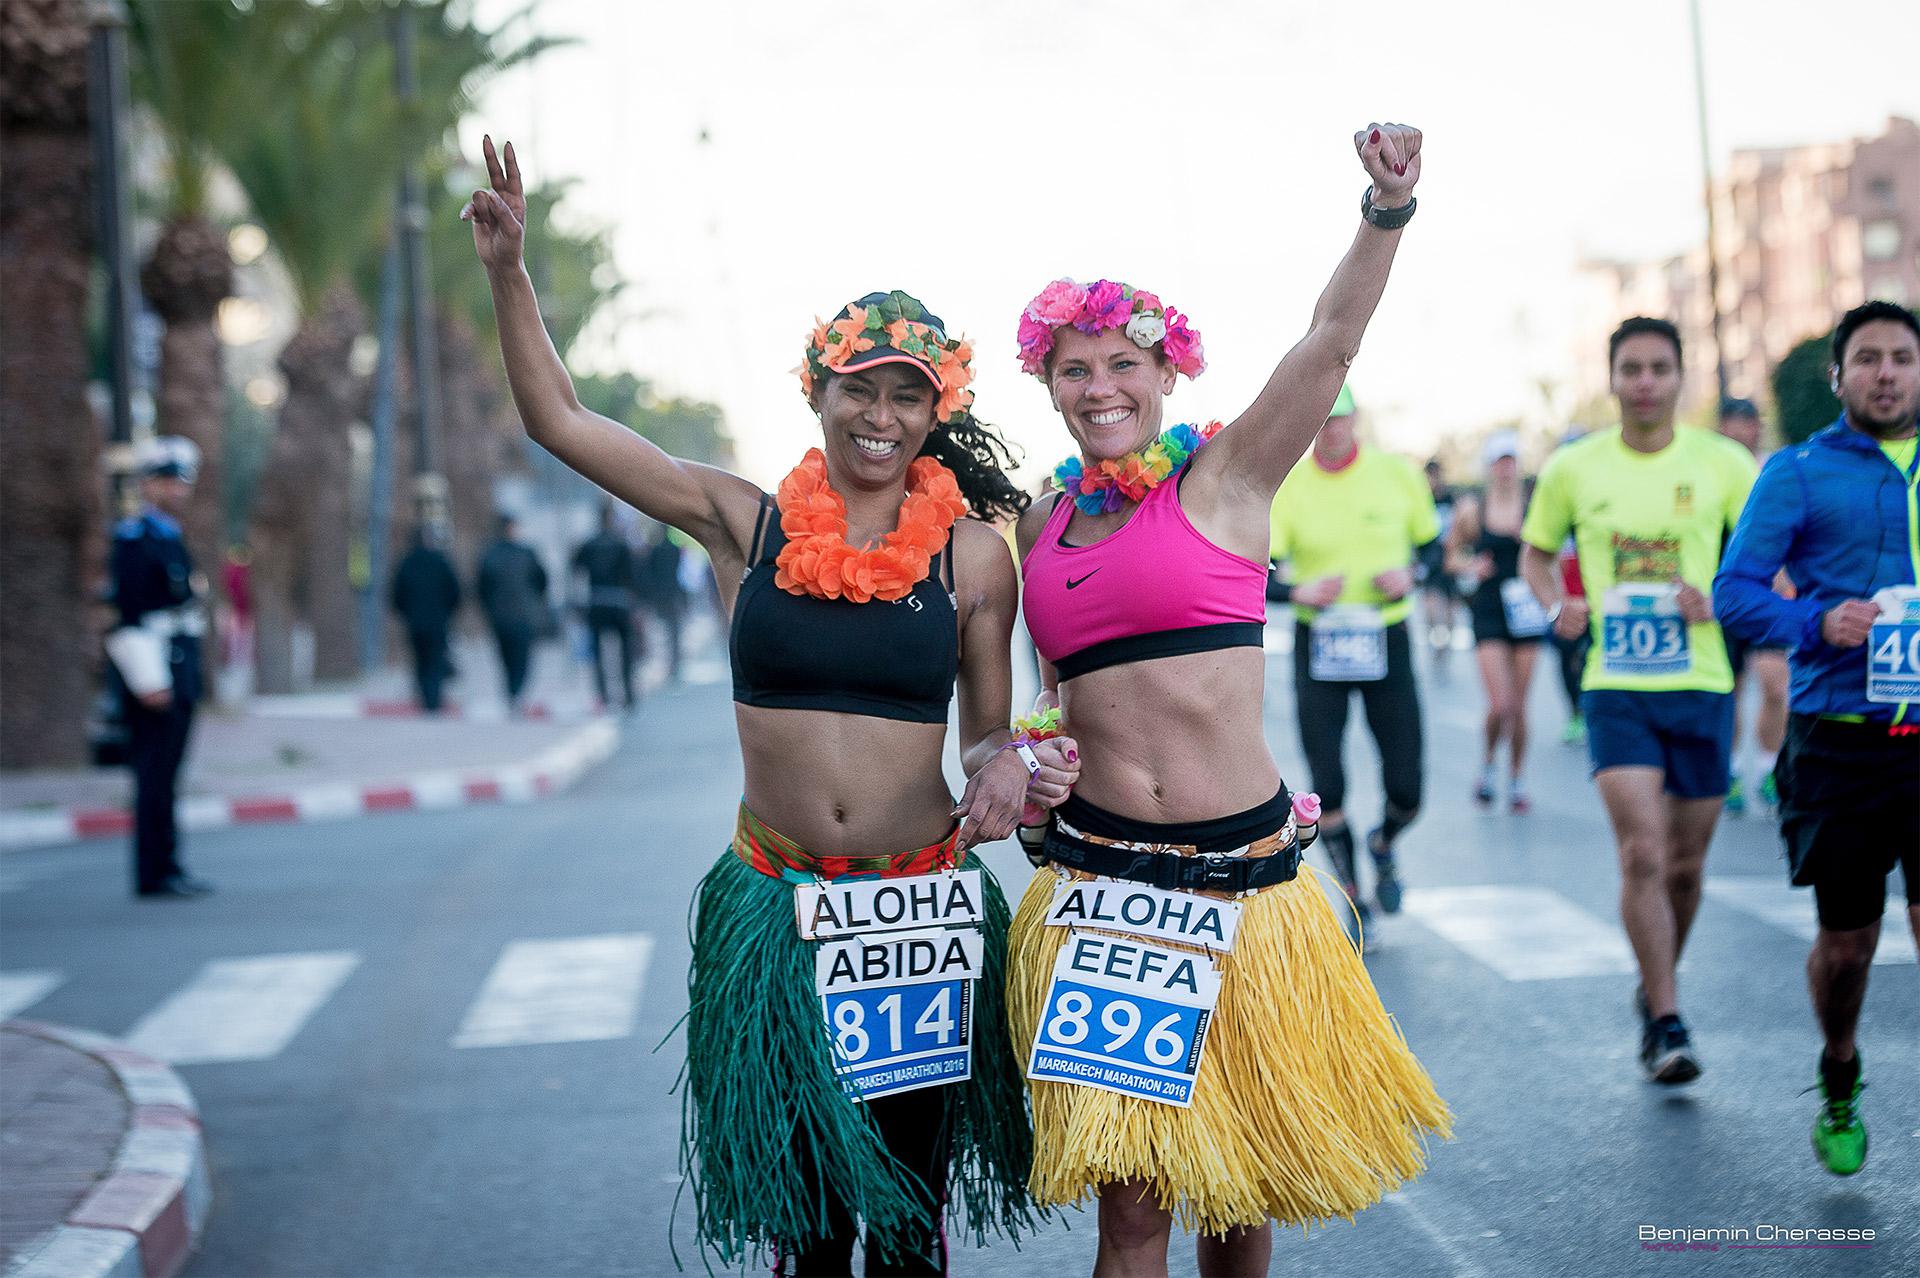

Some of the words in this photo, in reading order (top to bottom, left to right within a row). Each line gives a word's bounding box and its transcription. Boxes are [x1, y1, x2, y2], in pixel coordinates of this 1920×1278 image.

[1606, 619, 1682, 659] 303
[810, 879, 976, 932] ALOHA
[1054, 888, 1225, 942] ALOHA
[826, 936, 971, 987] ABIDA
[1071, 938, 1198, 995] EEFA
[833, 987, 955, 1062] 814
[1047, 990, 1185, 1066] 896
[893, 1062, 942, 1082] MARATHON
[943, 1058, 965, 1073] 2016
[1037, 1055, 1103, 1079] MARRAKECH
[1103, 1069, 1162, 1093] MARATHON
[1162, 1081, 1186, 1097] 2016
